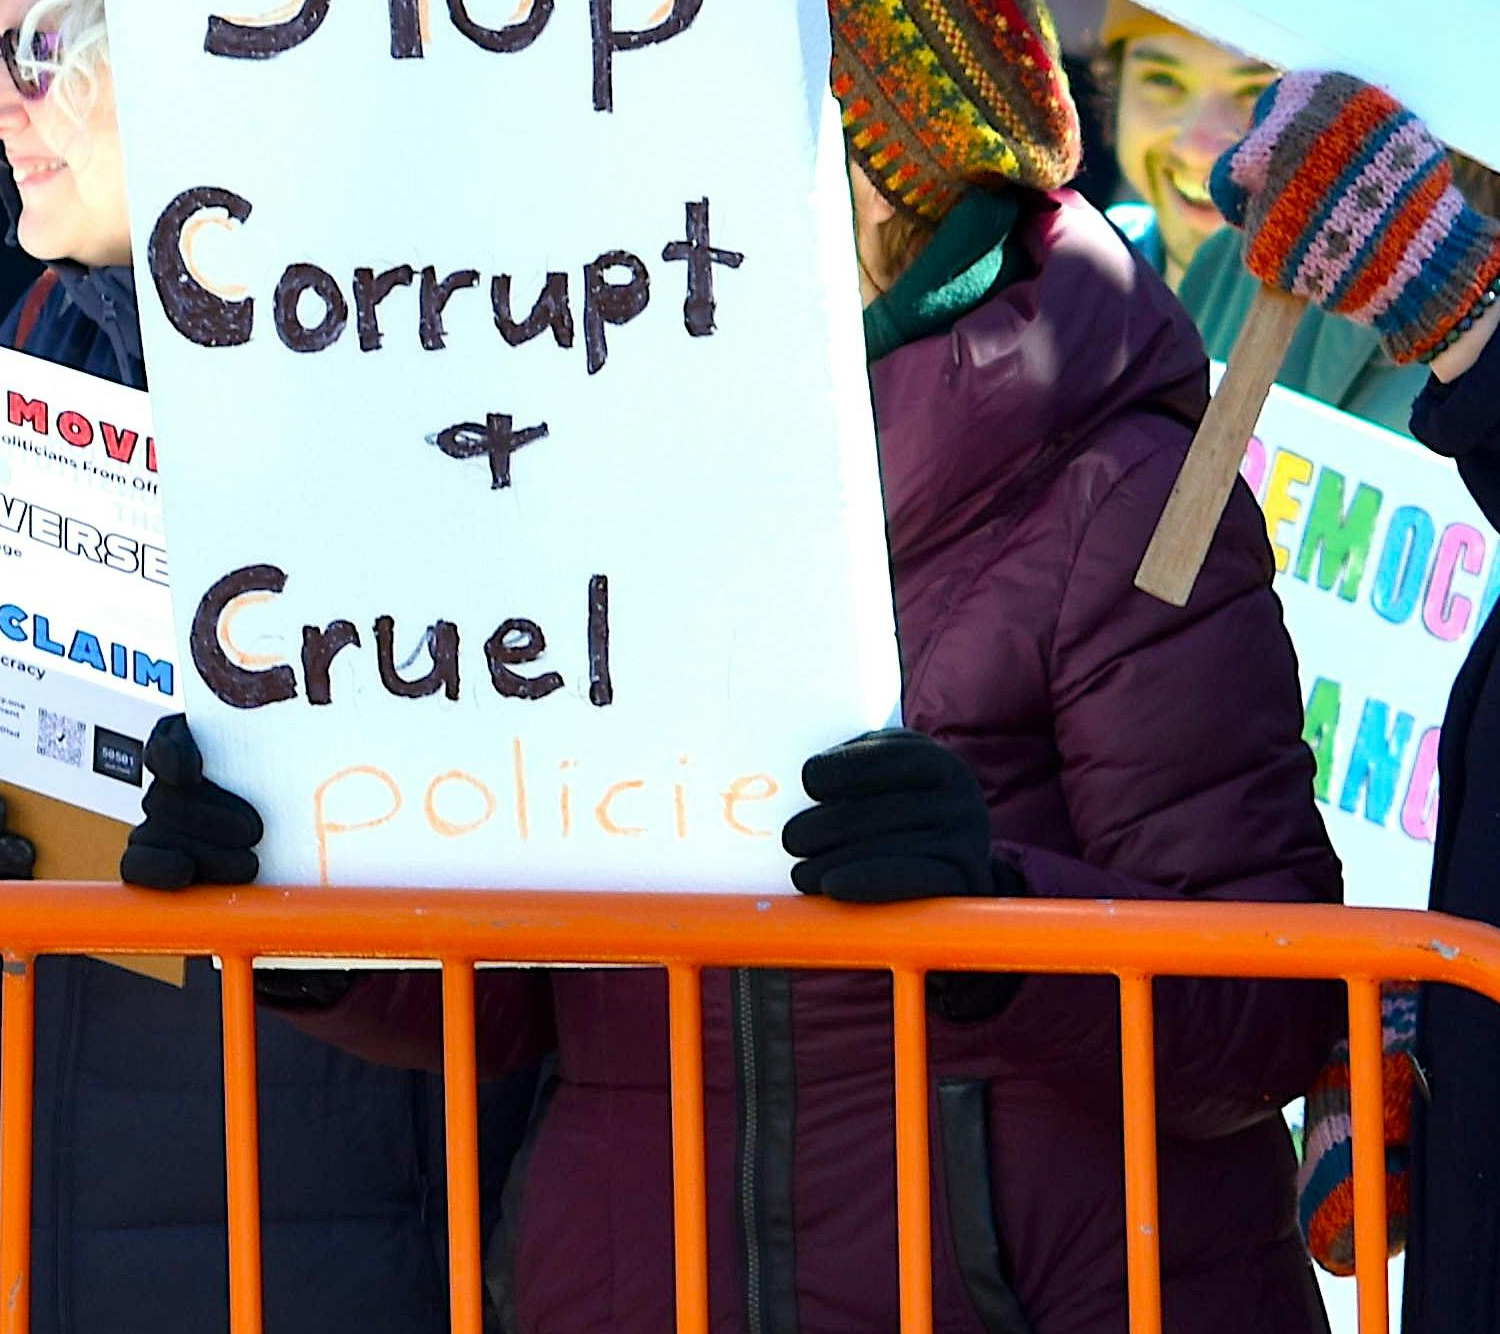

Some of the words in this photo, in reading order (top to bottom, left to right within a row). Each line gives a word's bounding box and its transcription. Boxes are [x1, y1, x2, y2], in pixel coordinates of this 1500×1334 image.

[148, 185, 745, 376] Corrupt
[84, 459, 127, 485] From
[191, 563, 614, 711] Cruel
[313, 735, 781, 888] policie
